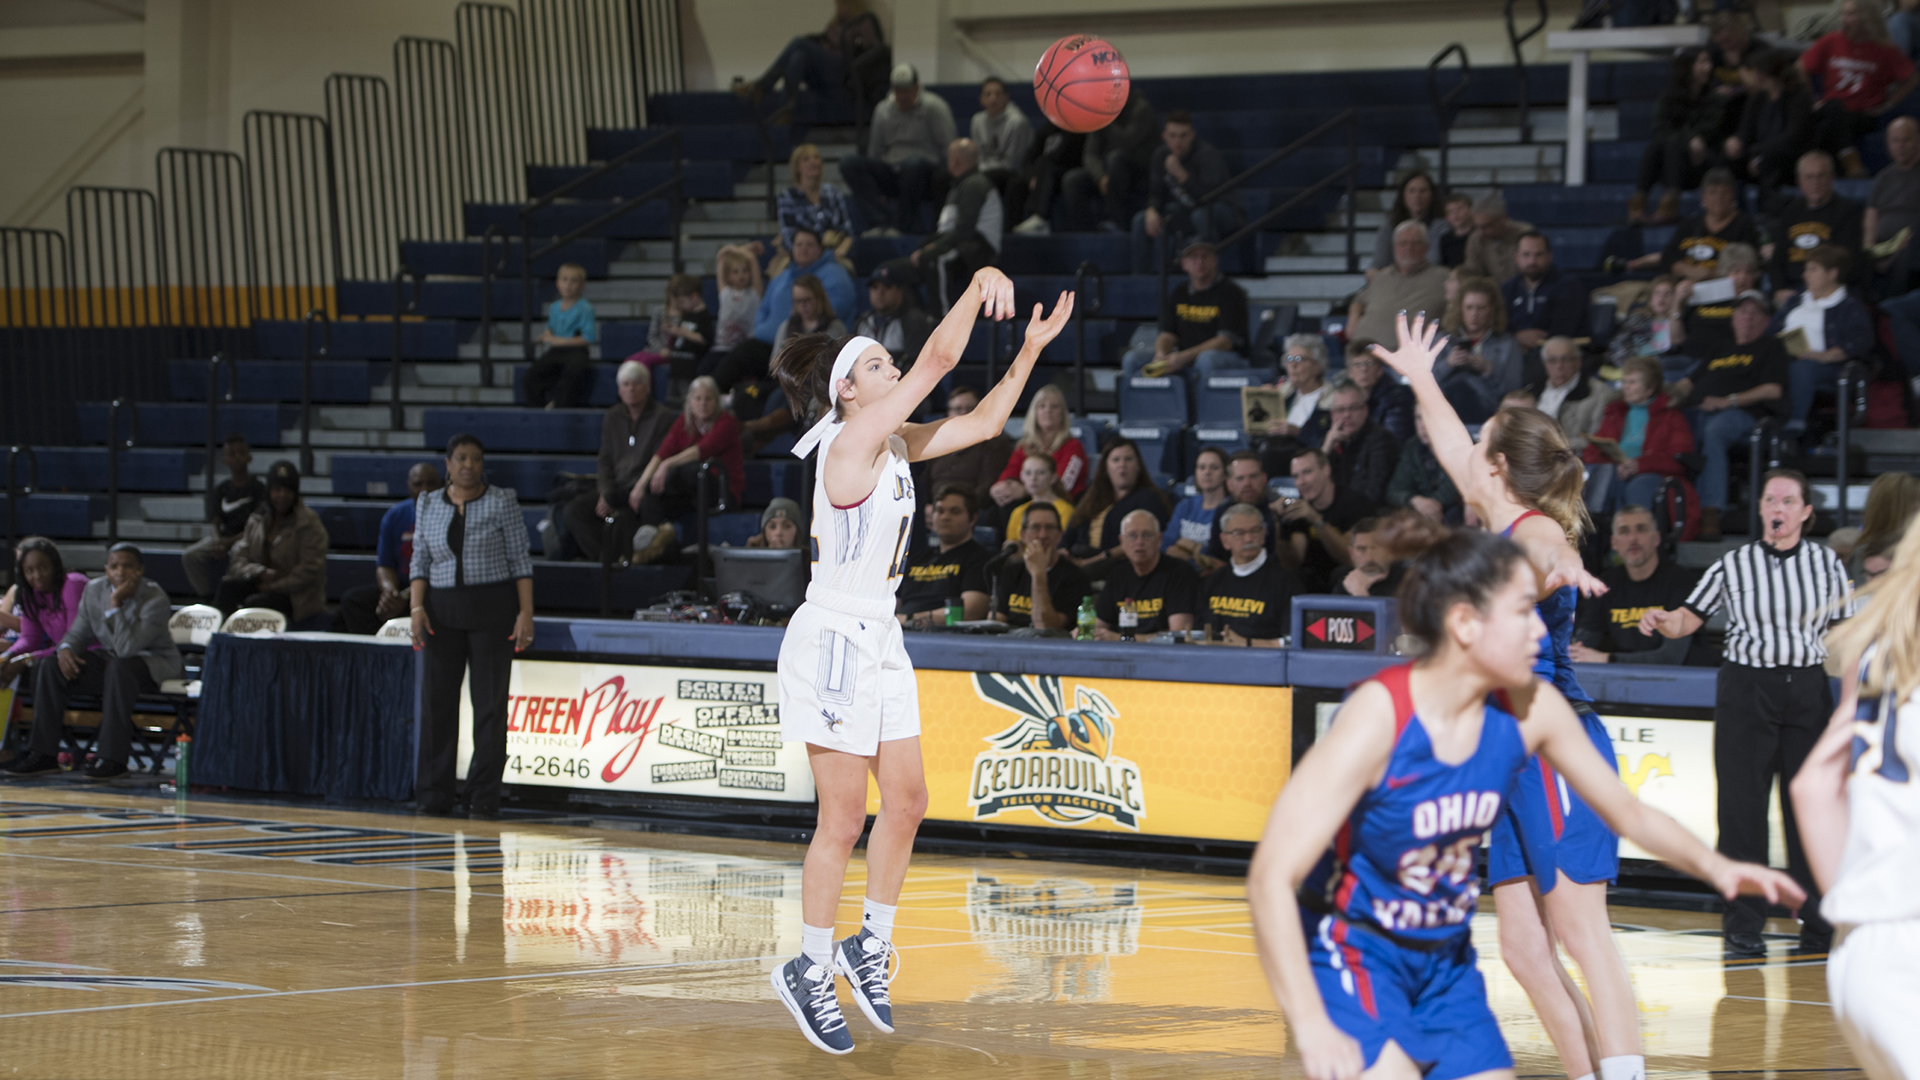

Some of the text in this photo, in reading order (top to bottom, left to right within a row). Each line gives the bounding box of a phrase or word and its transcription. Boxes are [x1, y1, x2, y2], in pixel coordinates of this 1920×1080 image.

[1327, 617, 1354, 643] POSS
[680, 681, 761, 695] SCREEN
[697, 704, 778, 720] OFFSET
[507, 735, 579, 748] INTING
[661, 724, 723, 750] DESIGN
[728, 730, 781, 742] BANNERS
[973, 756, 1141, 811] CEDARVILLE
[1001, 795, 1115, 814] YELLOW JACKETS
[1413, 791, 1501, 838] OHIO
